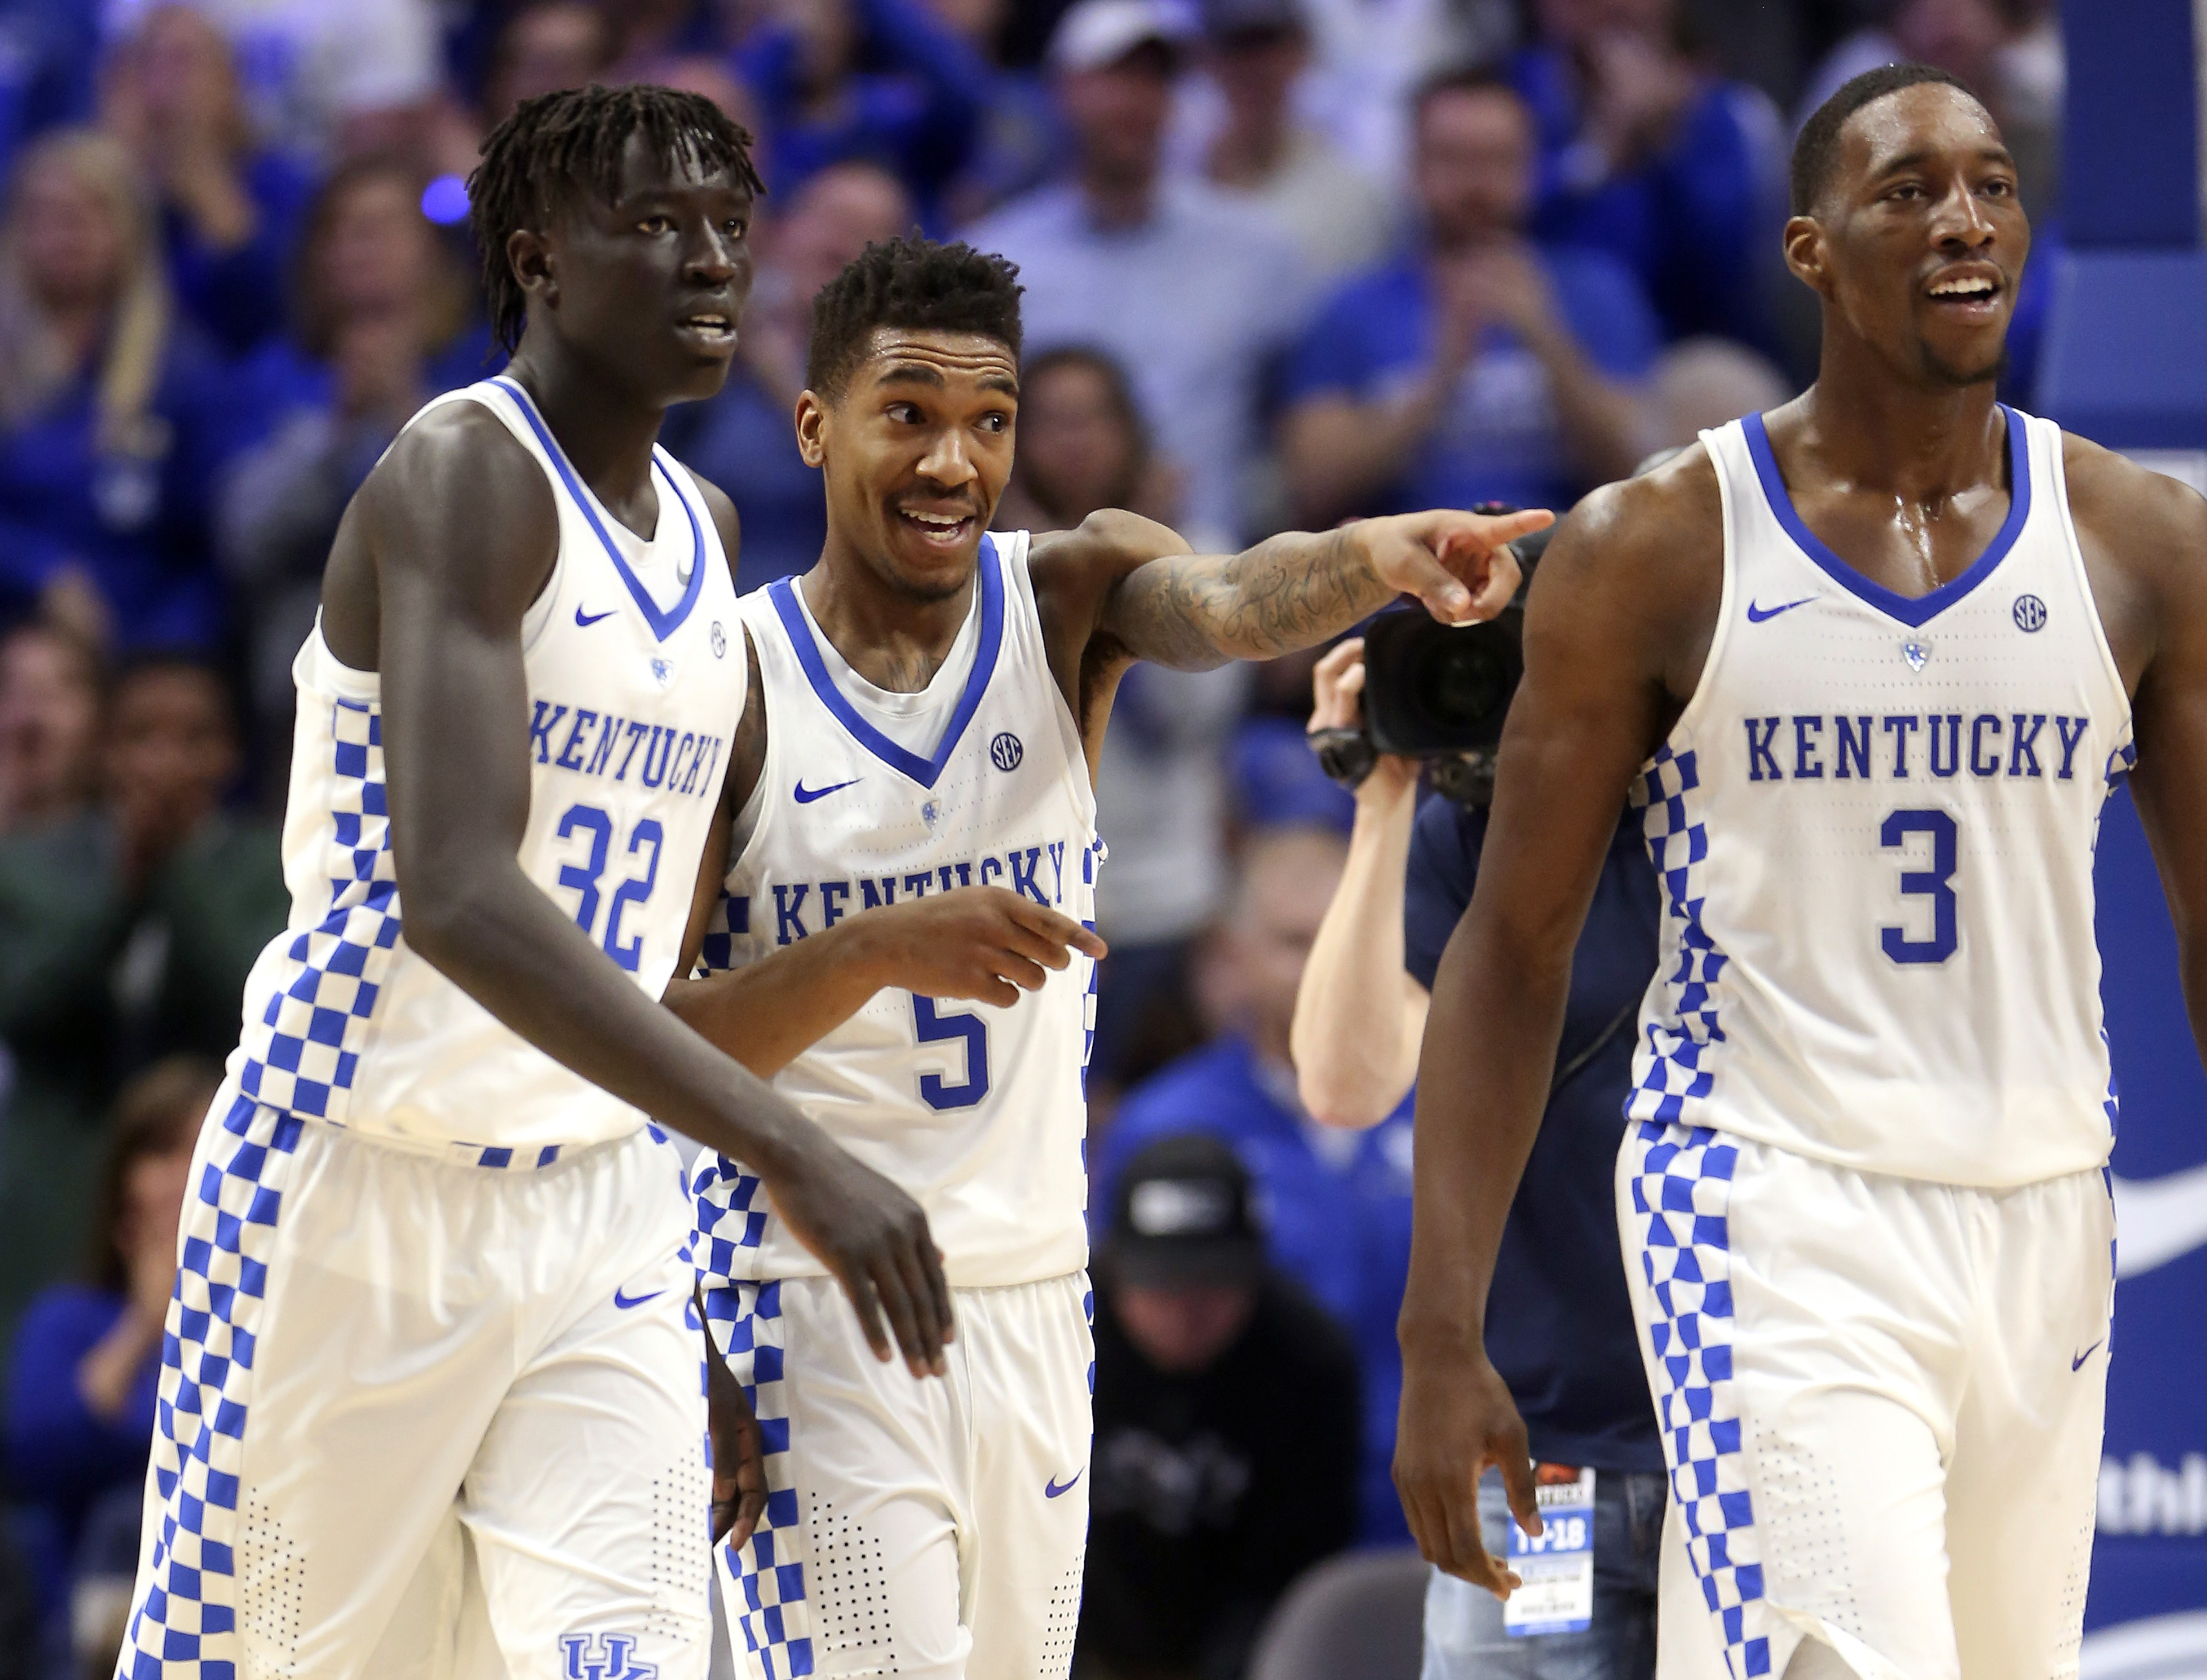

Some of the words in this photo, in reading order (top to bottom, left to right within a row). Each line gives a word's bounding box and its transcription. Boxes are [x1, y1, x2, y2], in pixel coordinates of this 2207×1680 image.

[2014, 596, 2046, 631] SEC
[530, 700, 722, 798] KENTUCKY
[992, 733, 1022, 770] SEC
[1744, 713, 2088, 781] KENTUCKY
[557, 804, 662, 971] 32
[1881, 810, 1957, 963] 3
[912, 993, 989, 1110] 5
